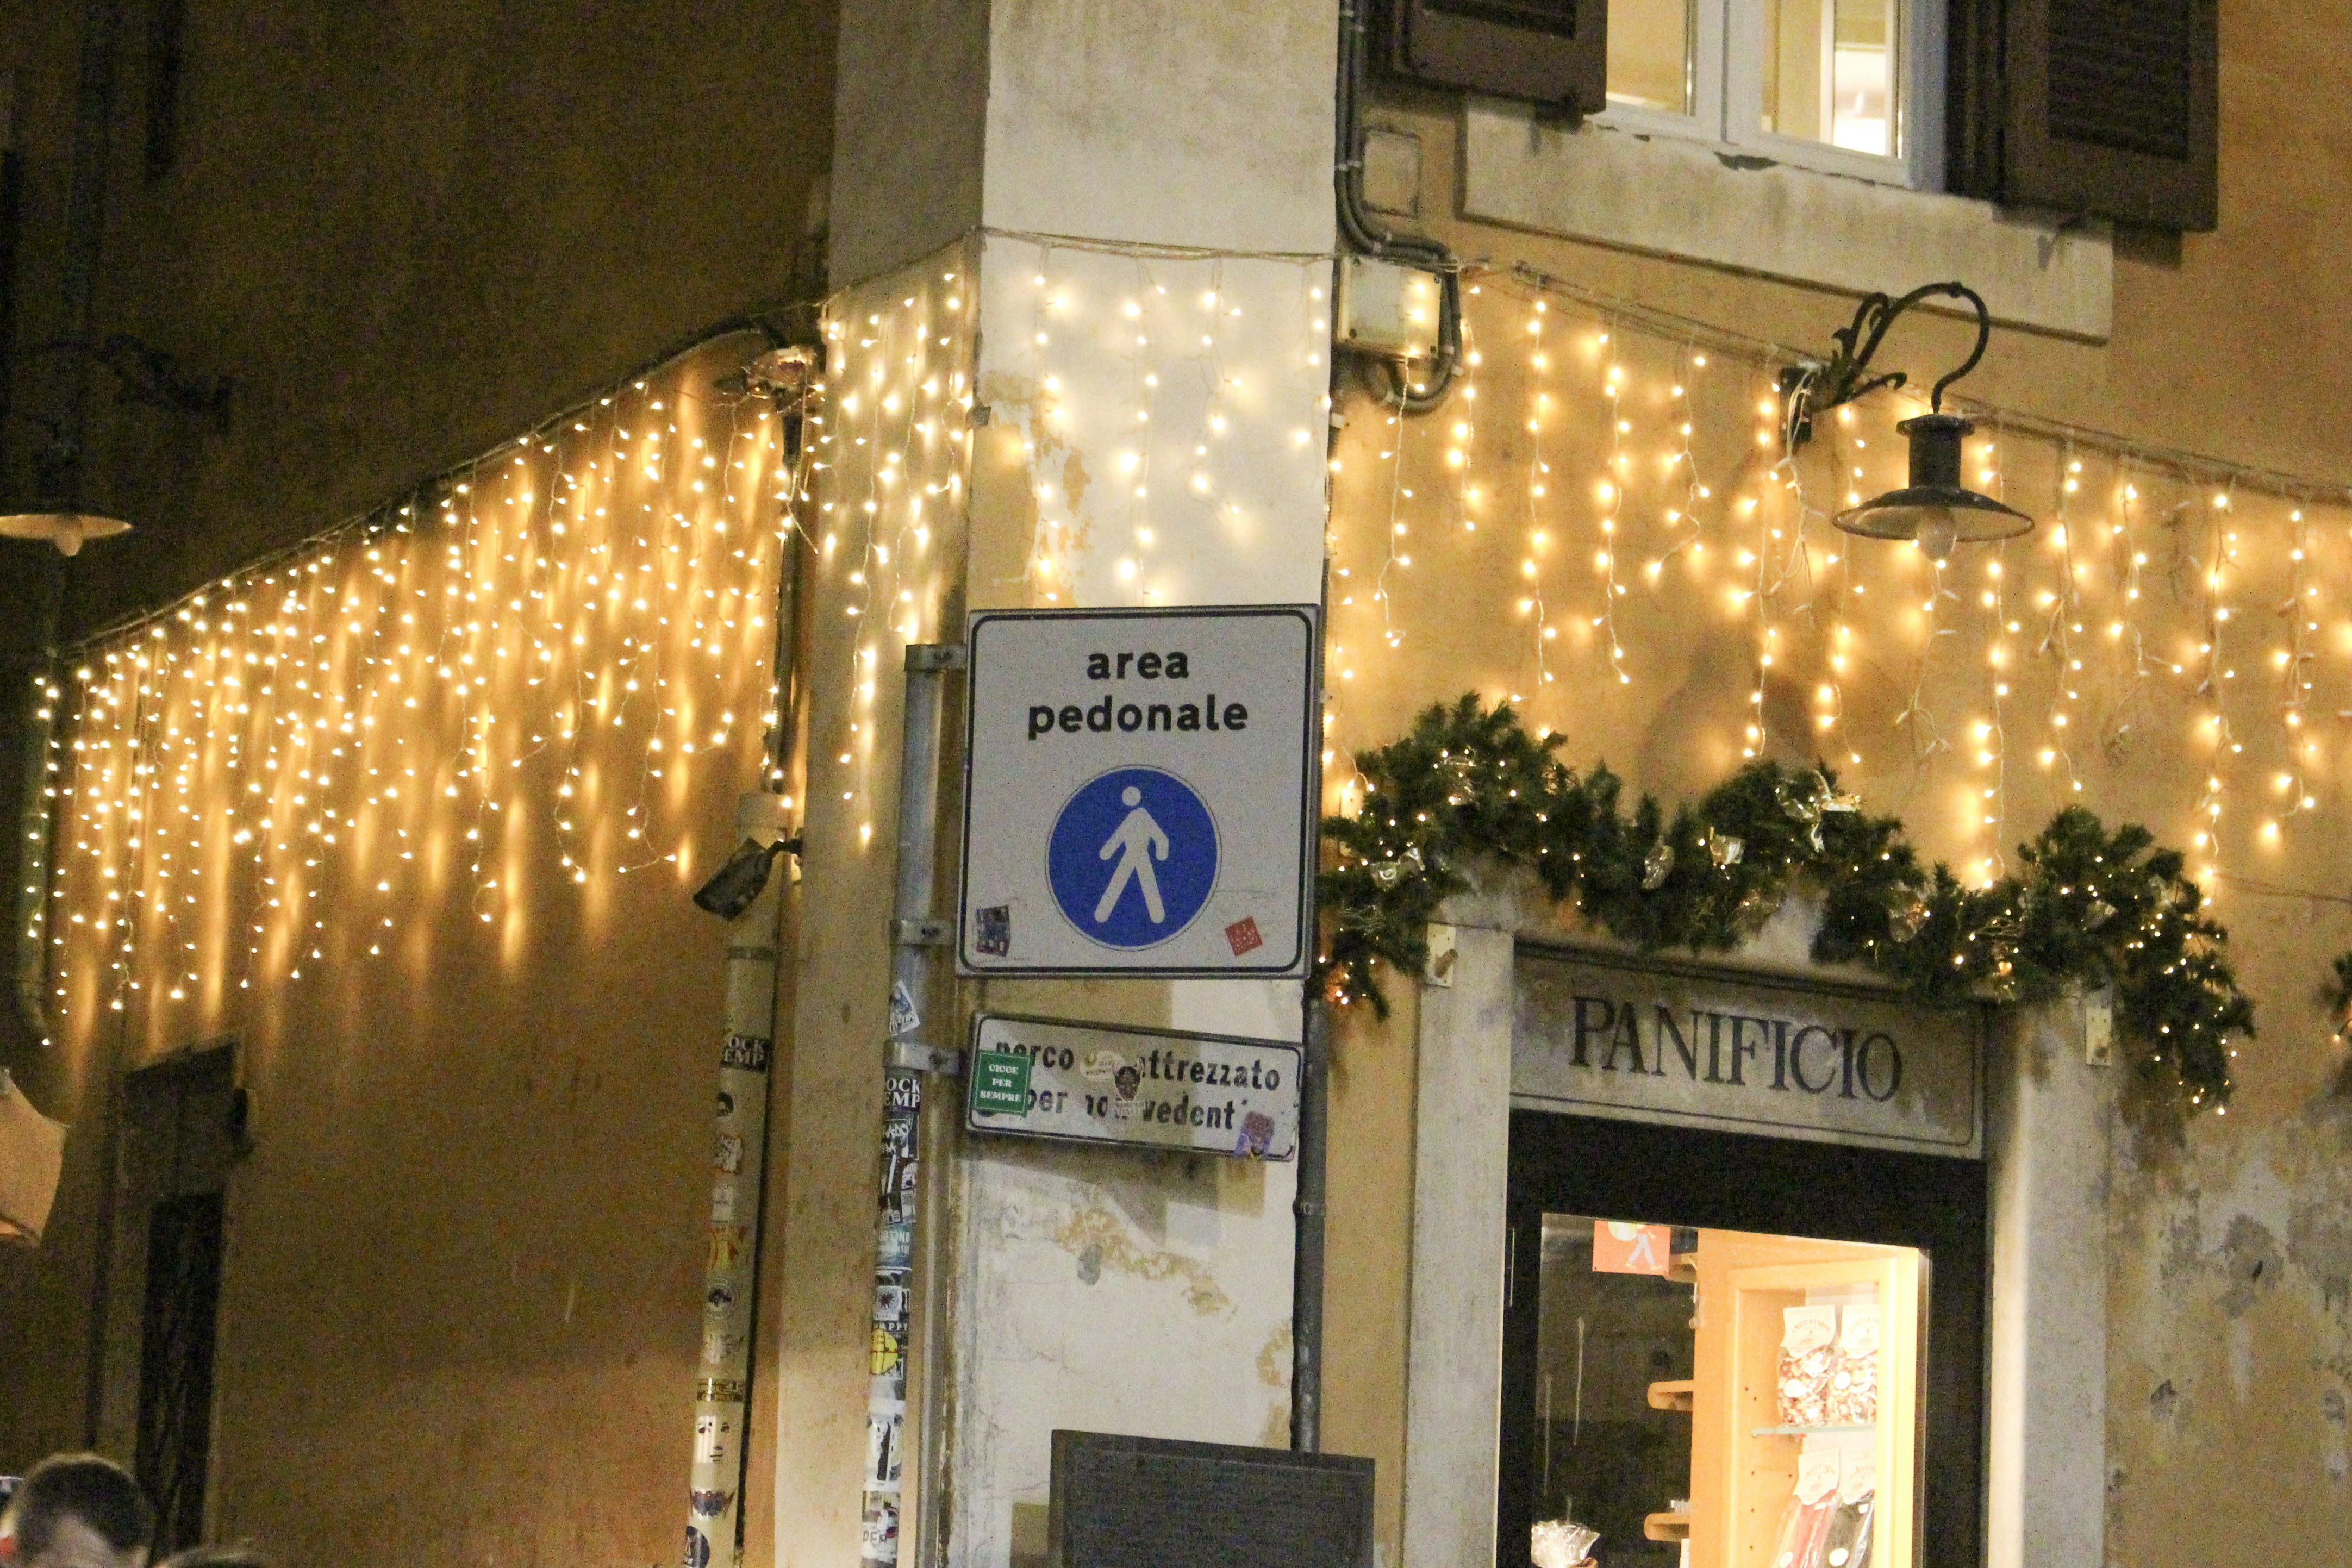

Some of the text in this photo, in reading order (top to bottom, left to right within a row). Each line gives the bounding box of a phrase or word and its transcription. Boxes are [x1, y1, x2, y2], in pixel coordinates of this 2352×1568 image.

[1087, 652, 1189, 679] area
[1028, 694, 1249, 740] pedonale
[1139, 1050, 1280, 1090] ttrezzato
[1569, 996, 1902, 1102] PANIFICIO
